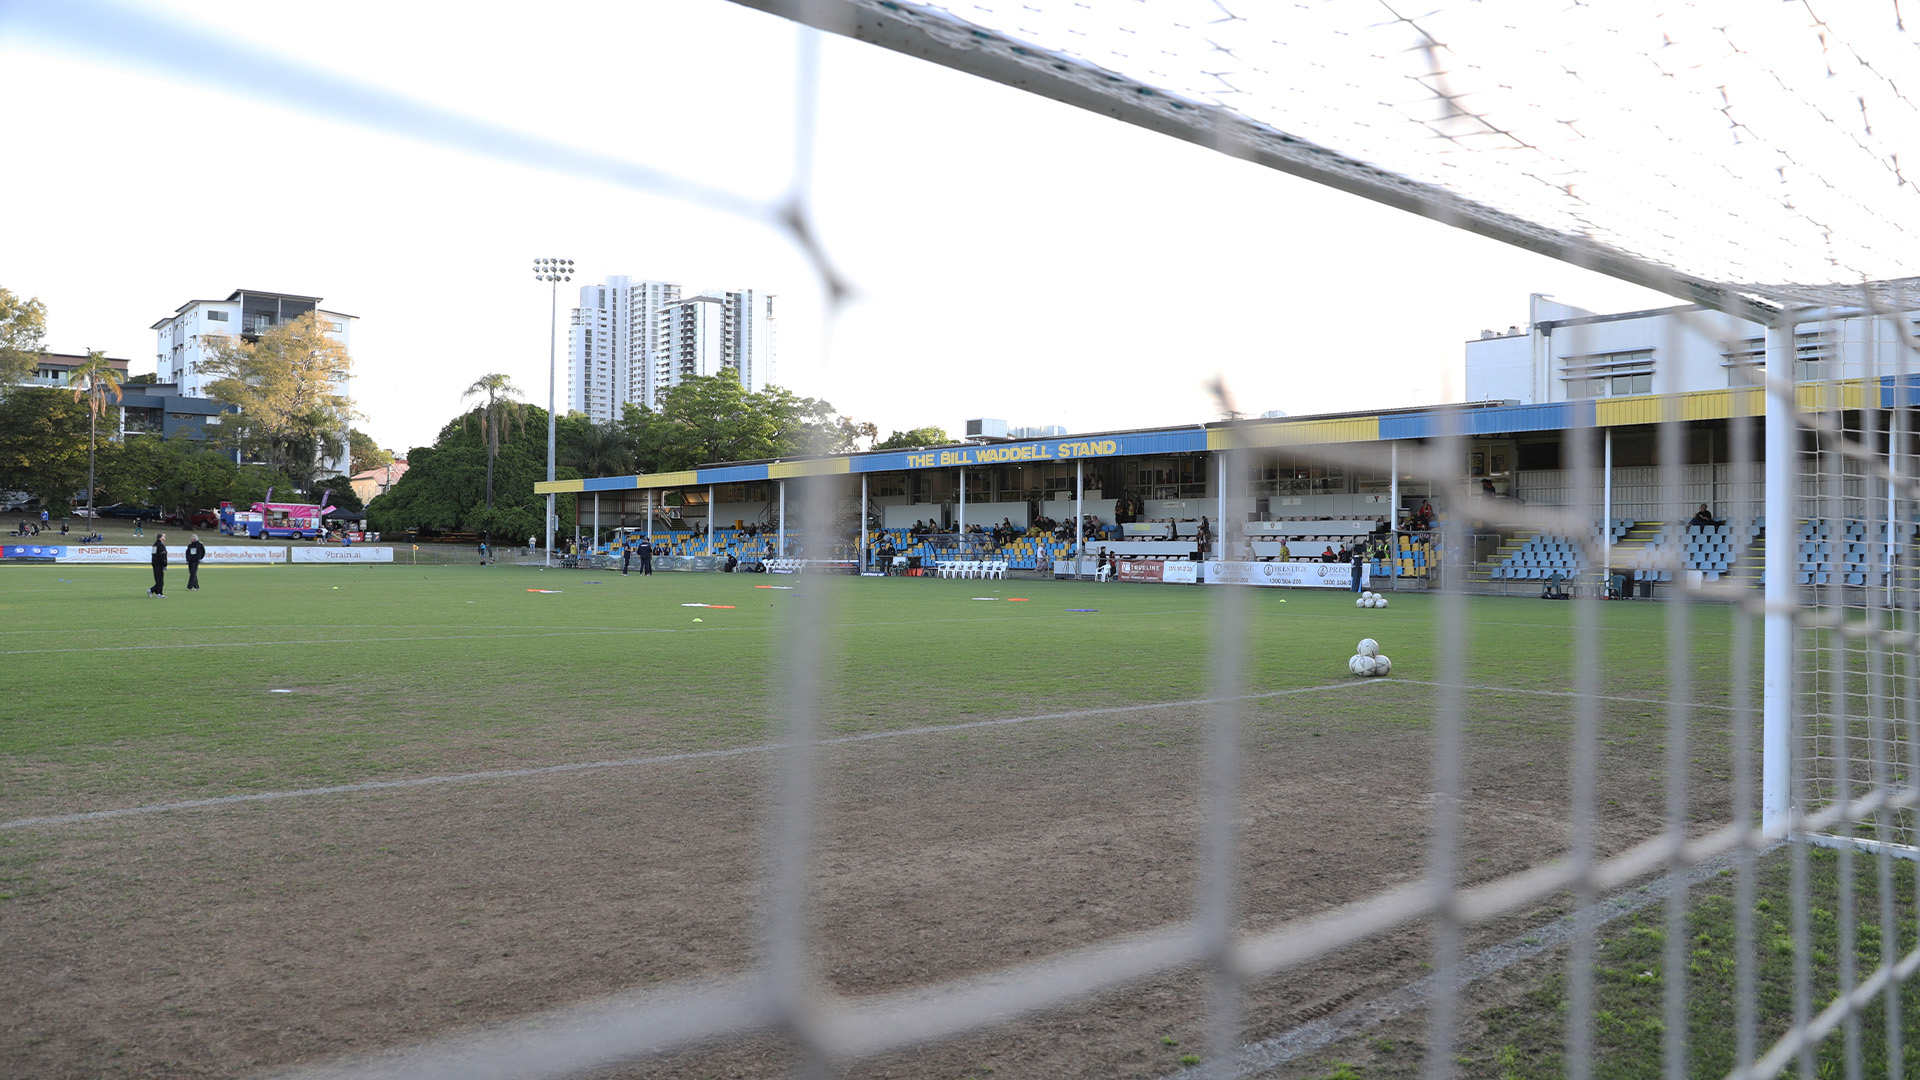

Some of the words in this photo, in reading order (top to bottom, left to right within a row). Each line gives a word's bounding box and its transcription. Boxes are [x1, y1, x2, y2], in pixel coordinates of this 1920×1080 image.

[907, 453, 935, 467] THE
[941, 451, 972, 466] BILL
[976, 445, 1051, 463] WADDELL
[1058, 440, 1117, 457] STAND
[78, 547, 128, 555] INSPIRE
[325, 550, 361, 558] 9brain.ai
[1274, 565, 1307, 573] PRESTIGE
